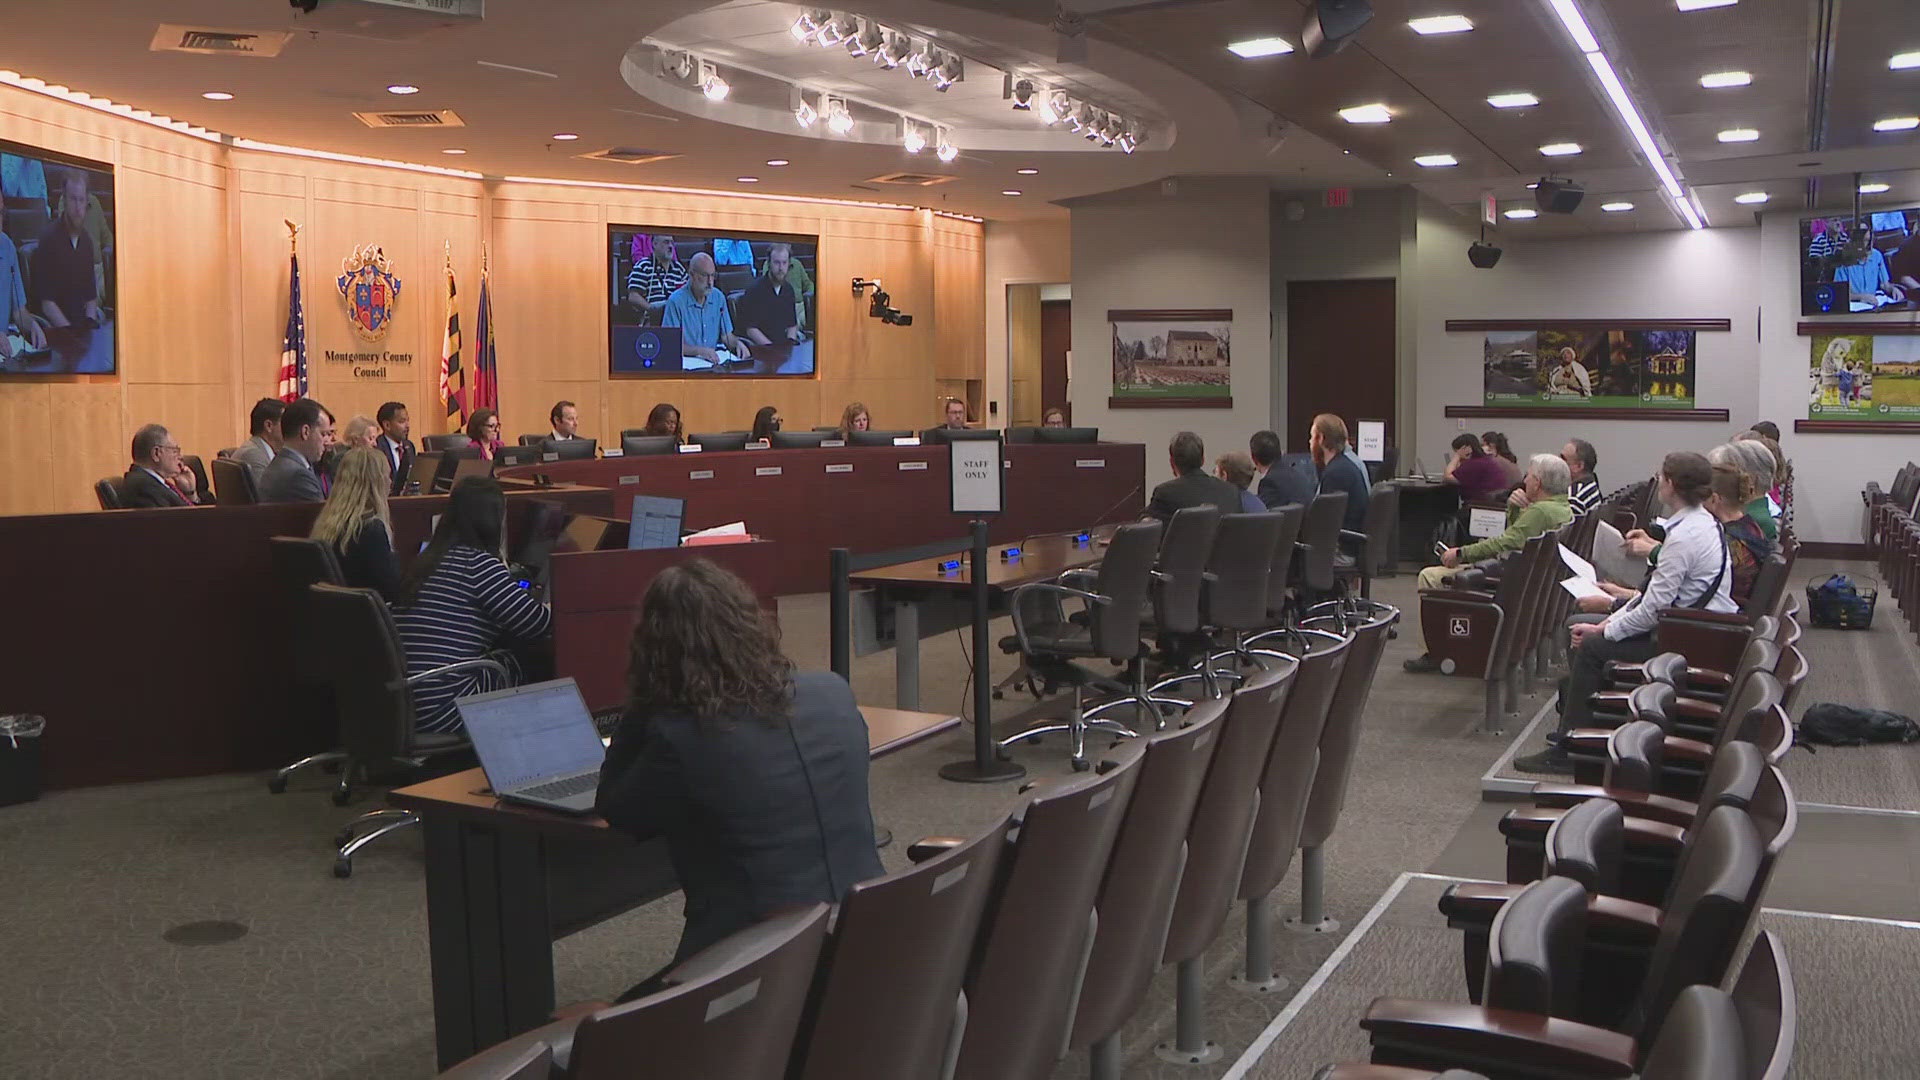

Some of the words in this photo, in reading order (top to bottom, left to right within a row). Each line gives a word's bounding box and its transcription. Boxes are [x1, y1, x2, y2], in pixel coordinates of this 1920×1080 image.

[325, 351, 380, 364] Montgomery
[383, 351, 412, 364] County
[354, 367, 386, 377] Council
